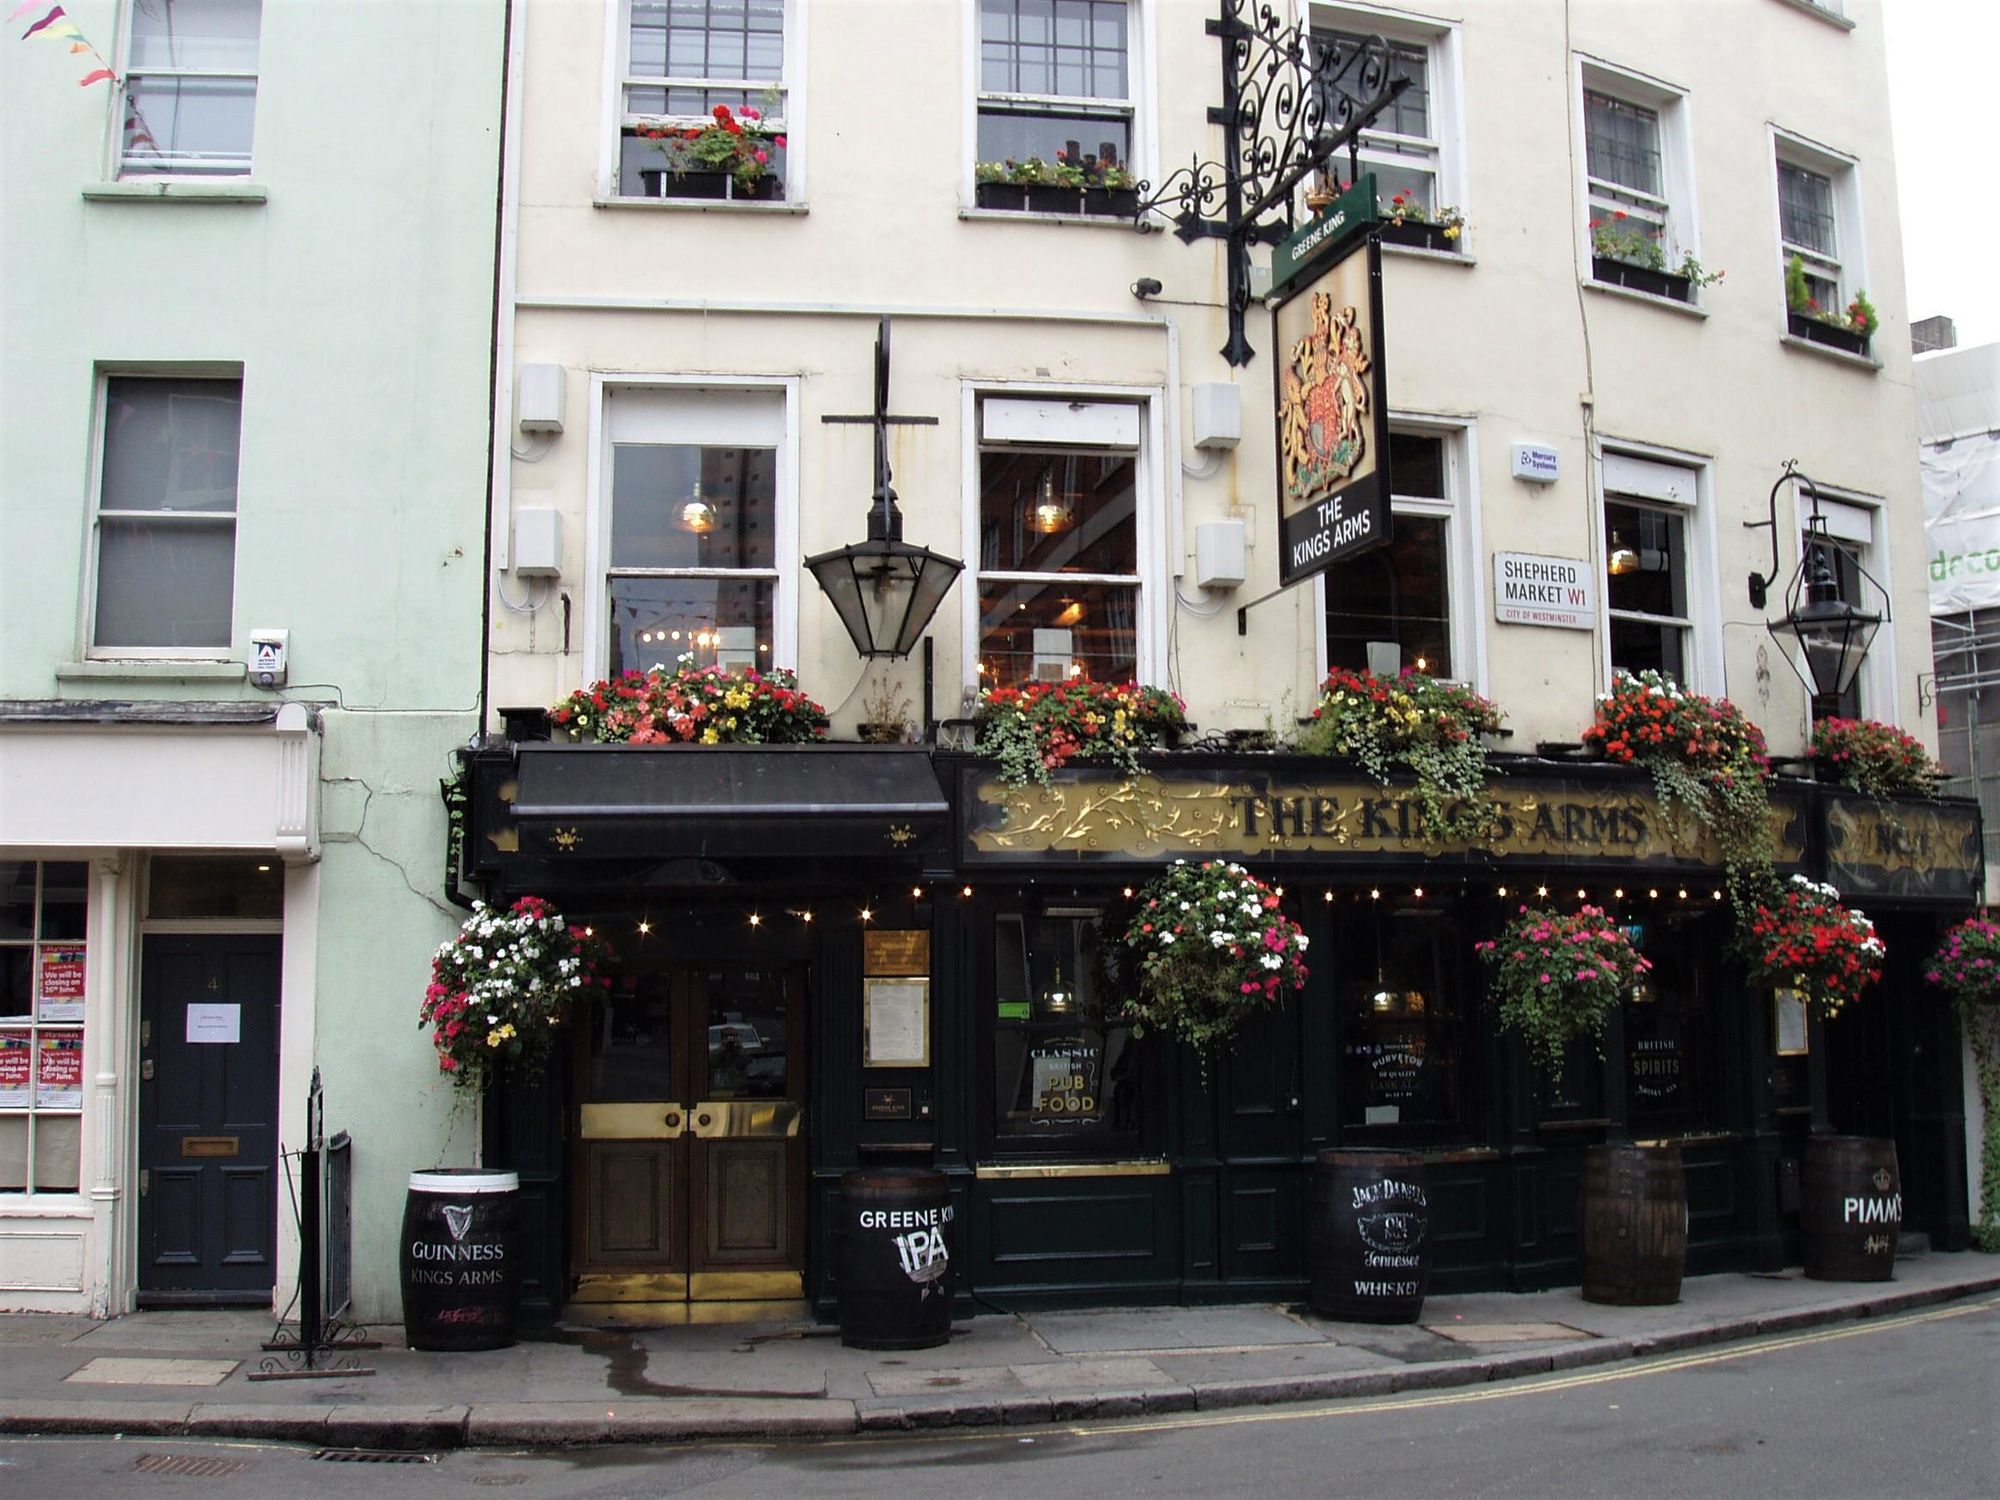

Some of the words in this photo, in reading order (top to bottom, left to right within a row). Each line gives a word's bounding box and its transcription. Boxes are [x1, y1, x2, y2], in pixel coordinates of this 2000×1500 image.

[1291, 227, 1323, 260] GREENE
[1323, 210, 1346, 237] KING
[1531, 451, 1557, 464] Mercury
[1532, 460, 1557, 471] Systems
[1317, 496, 1343, 529] THE
[1293, 524, 1331, 567] KINGS
[1334, 508, 1371, 549] ARMS
[1505, 560, 1577, 584] SHEPHERD
[1505, 582, 1562, 604] MARKET
[1567, 587, 1586, 606] W1
[1506, 609, 1520, 619] CITY
[1522, 611, 1531, 620] OF
[1532, 612, 1577, 624] WESTMINSTER
[1230, 794, 1341, 839] THE
[1528, 800, 1649, 845] ARMS
[44, 971, 57, 979] We
[58, 970, 72, 978] will
[44, 979, 70, 987] closing
[207, 976, 219, 992] 4
[1031, 1047, 1099, 1059] CLASSIC
[1637, 1040, 1675, 1051] BRITISH
[5, 1057, 18, 1065] will
[19, 1057, 29, 1065] be
[42, 1057, 55, 1065] We
[56, 1057, 70, 1065] will
[42, 1065, 68, 1074] closing
[1371, 1053, 1424, 1070] PURVEYOR
[1633, 1058, 1680, 1076] SPIRITS
[1048, 1075, 1084, 1091] PUB
[1038, 1096, 1094, 1112] FOOD
[1844, 1193, 1902, 1224] PIMM'S
[860, 1208, 938, 1229] GREENE
[412, 1241, 504, 1260] GUINNESS
[896, 1226, 949, 1274] IPA
[411, 1268, 453, 1285] KINGS
[458, 1269, 503, 1285] ARMS
[1354, 1280, 1420, 1297] WHISKEY
